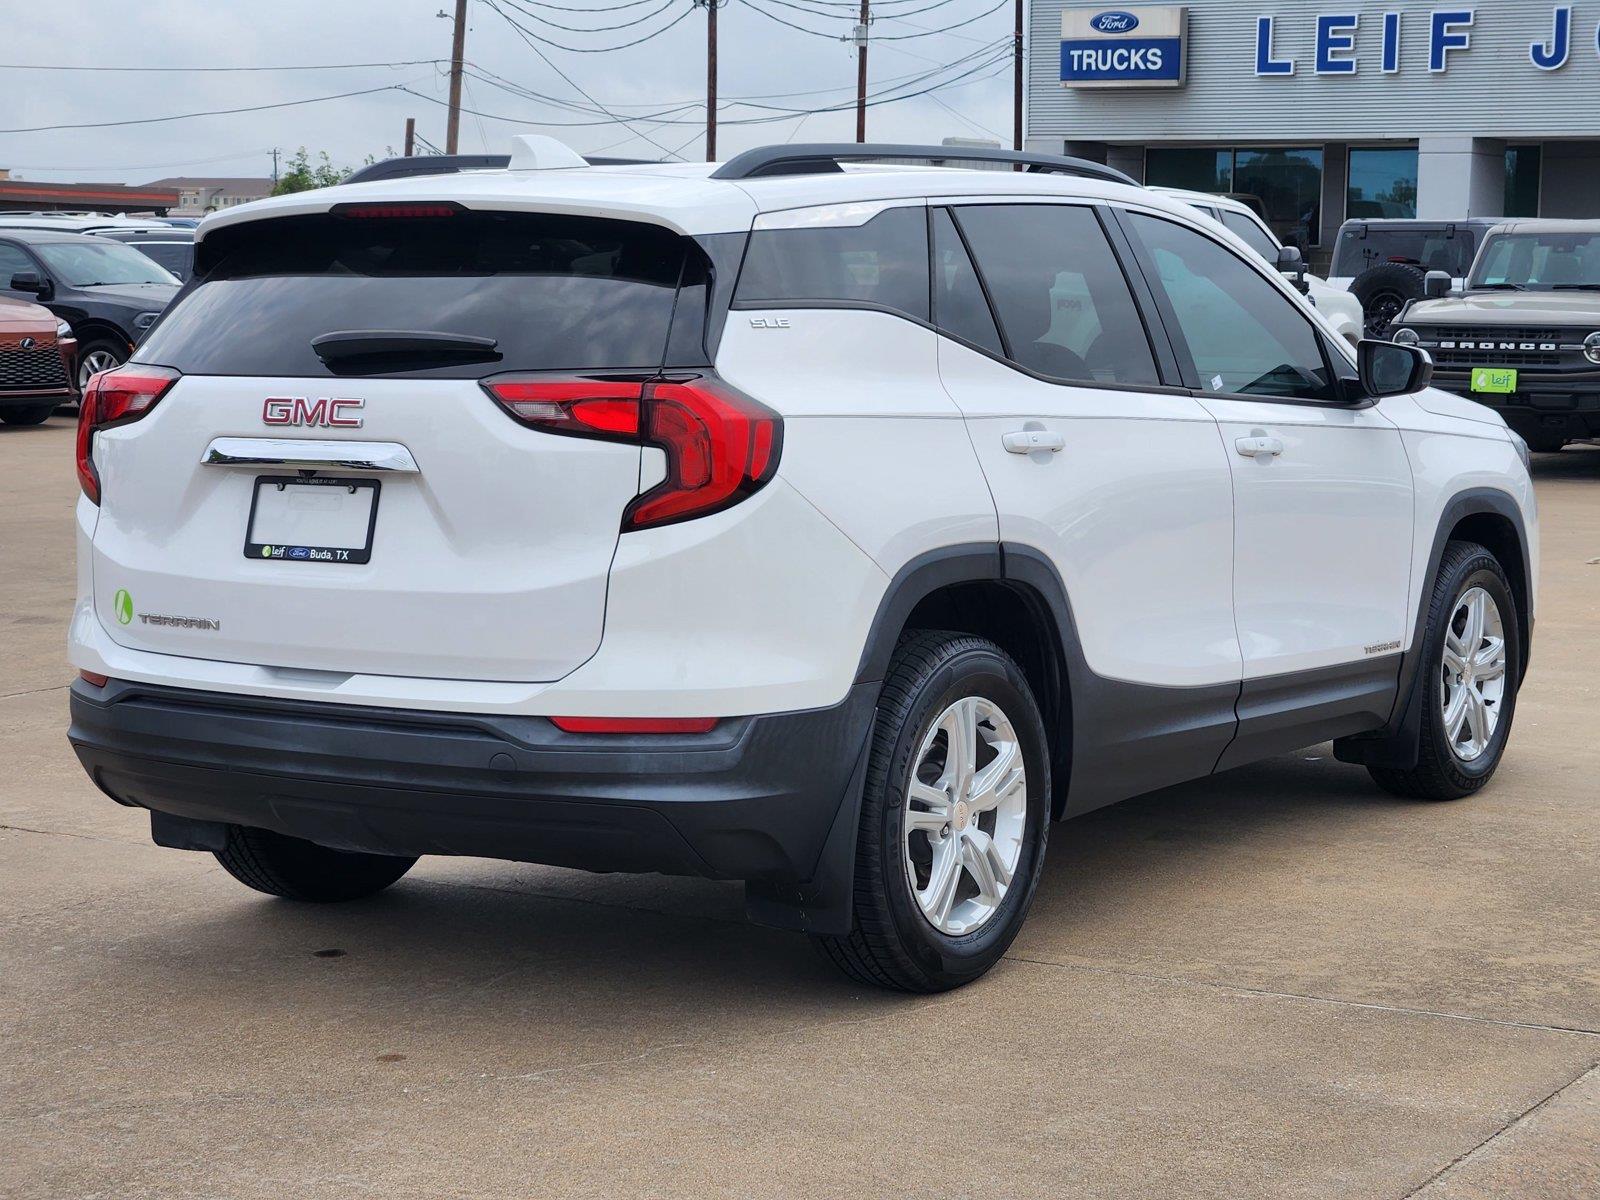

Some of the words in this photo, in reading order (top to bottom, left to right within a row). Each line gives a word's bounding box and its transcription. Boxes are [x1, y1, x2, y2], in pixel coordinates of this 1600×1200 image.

[1254, 10, 1475, 76] LEIF
[1529, 6, 1600, 71] J
[1069, 47, 1163, 71] TRUCKS
[749, 318, 792, 328] SLE
[1440, 341, 1556, 350] BRONCO
[263, 396, 364, 428] GMC
[310, 549, 334, 560] Buda,
[336, 550, 349, 560] TX
[138, 613, 220, 631] TERRAIN
